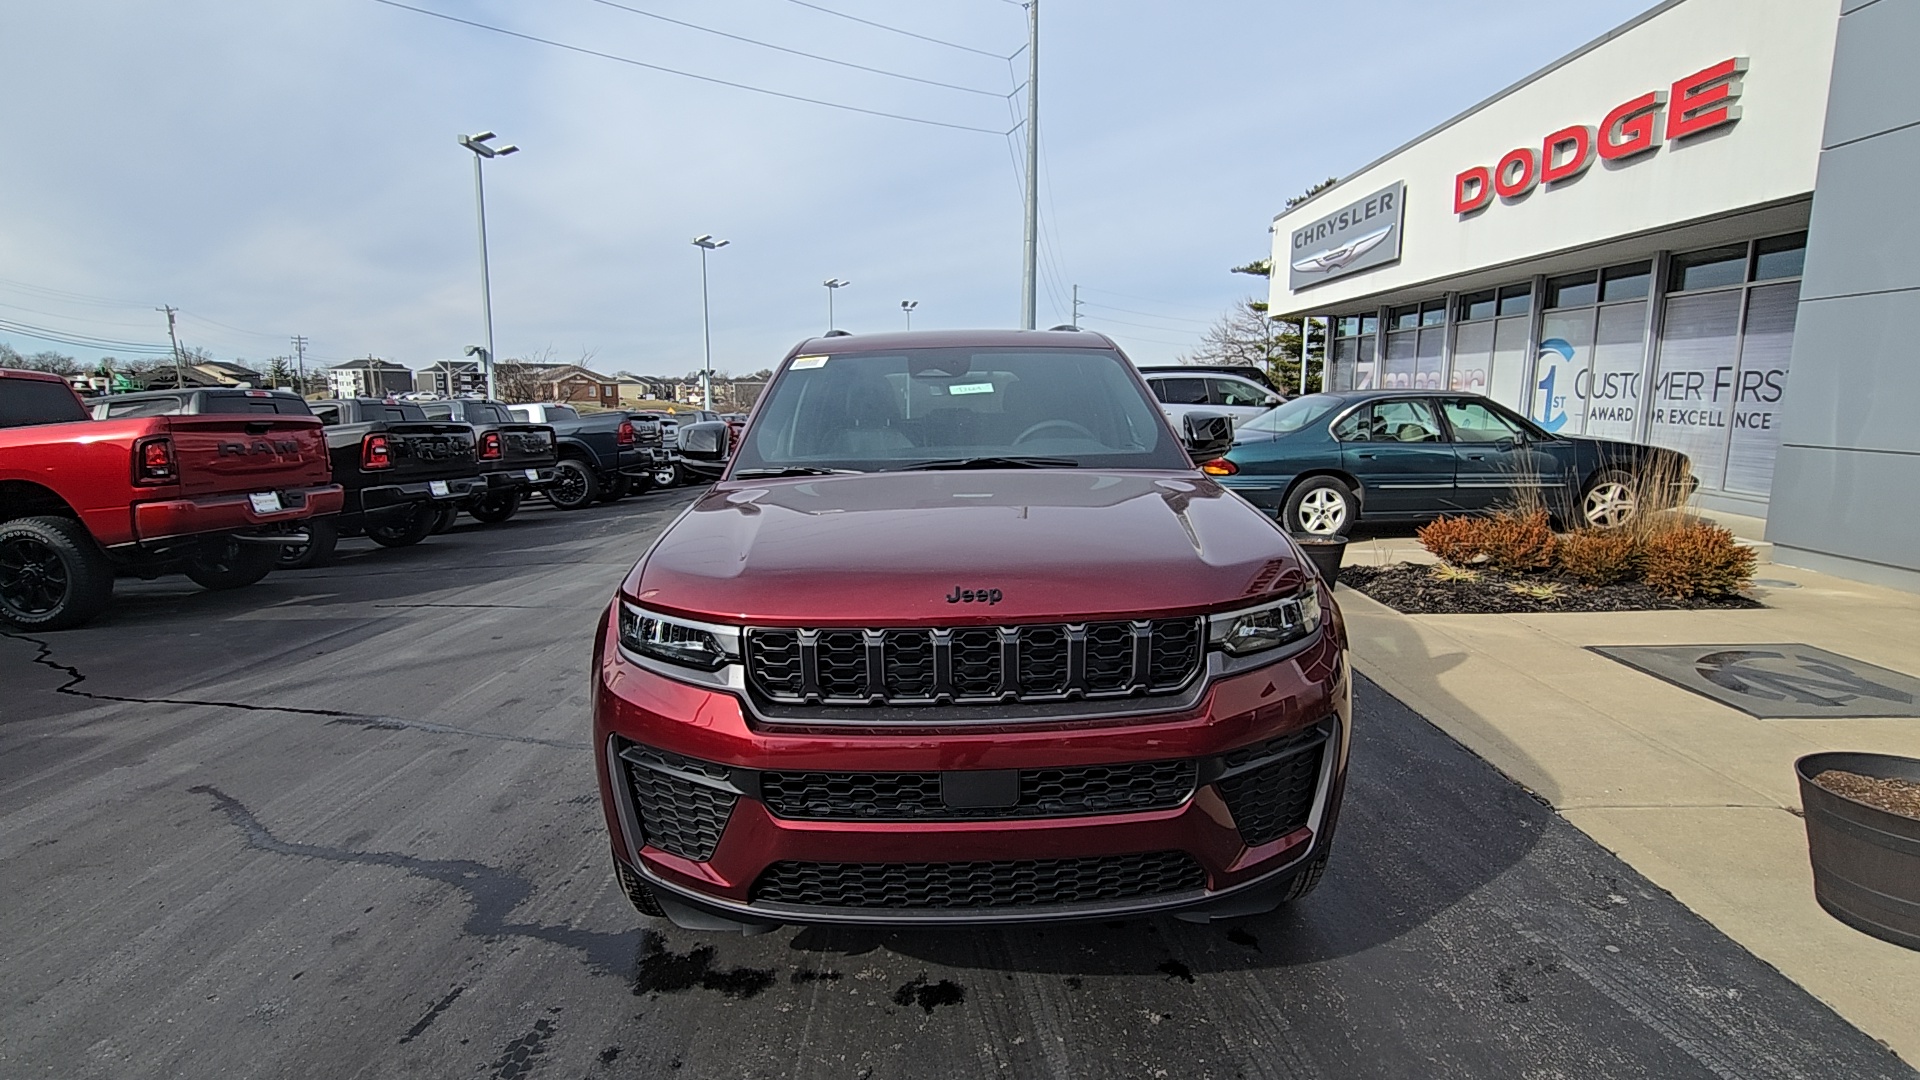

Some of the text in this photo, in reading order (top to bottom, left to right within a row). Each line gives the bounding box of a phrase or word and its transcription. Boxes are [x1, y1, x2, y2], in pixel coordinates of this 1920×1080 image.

[1454, 57, 1749, 214] DODGE
[1294, 192, 1394, 249] CHRYSLER
[1356, 362, 1486, 391] Zmmer
[1712, 366, 1790, 403] FIRS
[1589, 407, 1634, 422] AWARD
[1669, 409, 1772, 430] EXCELLNCE
[217, 440, 299, 457] RAM
[420, 441, 459, 452] RAM
[946, 586, 1003, 605] Jeep
